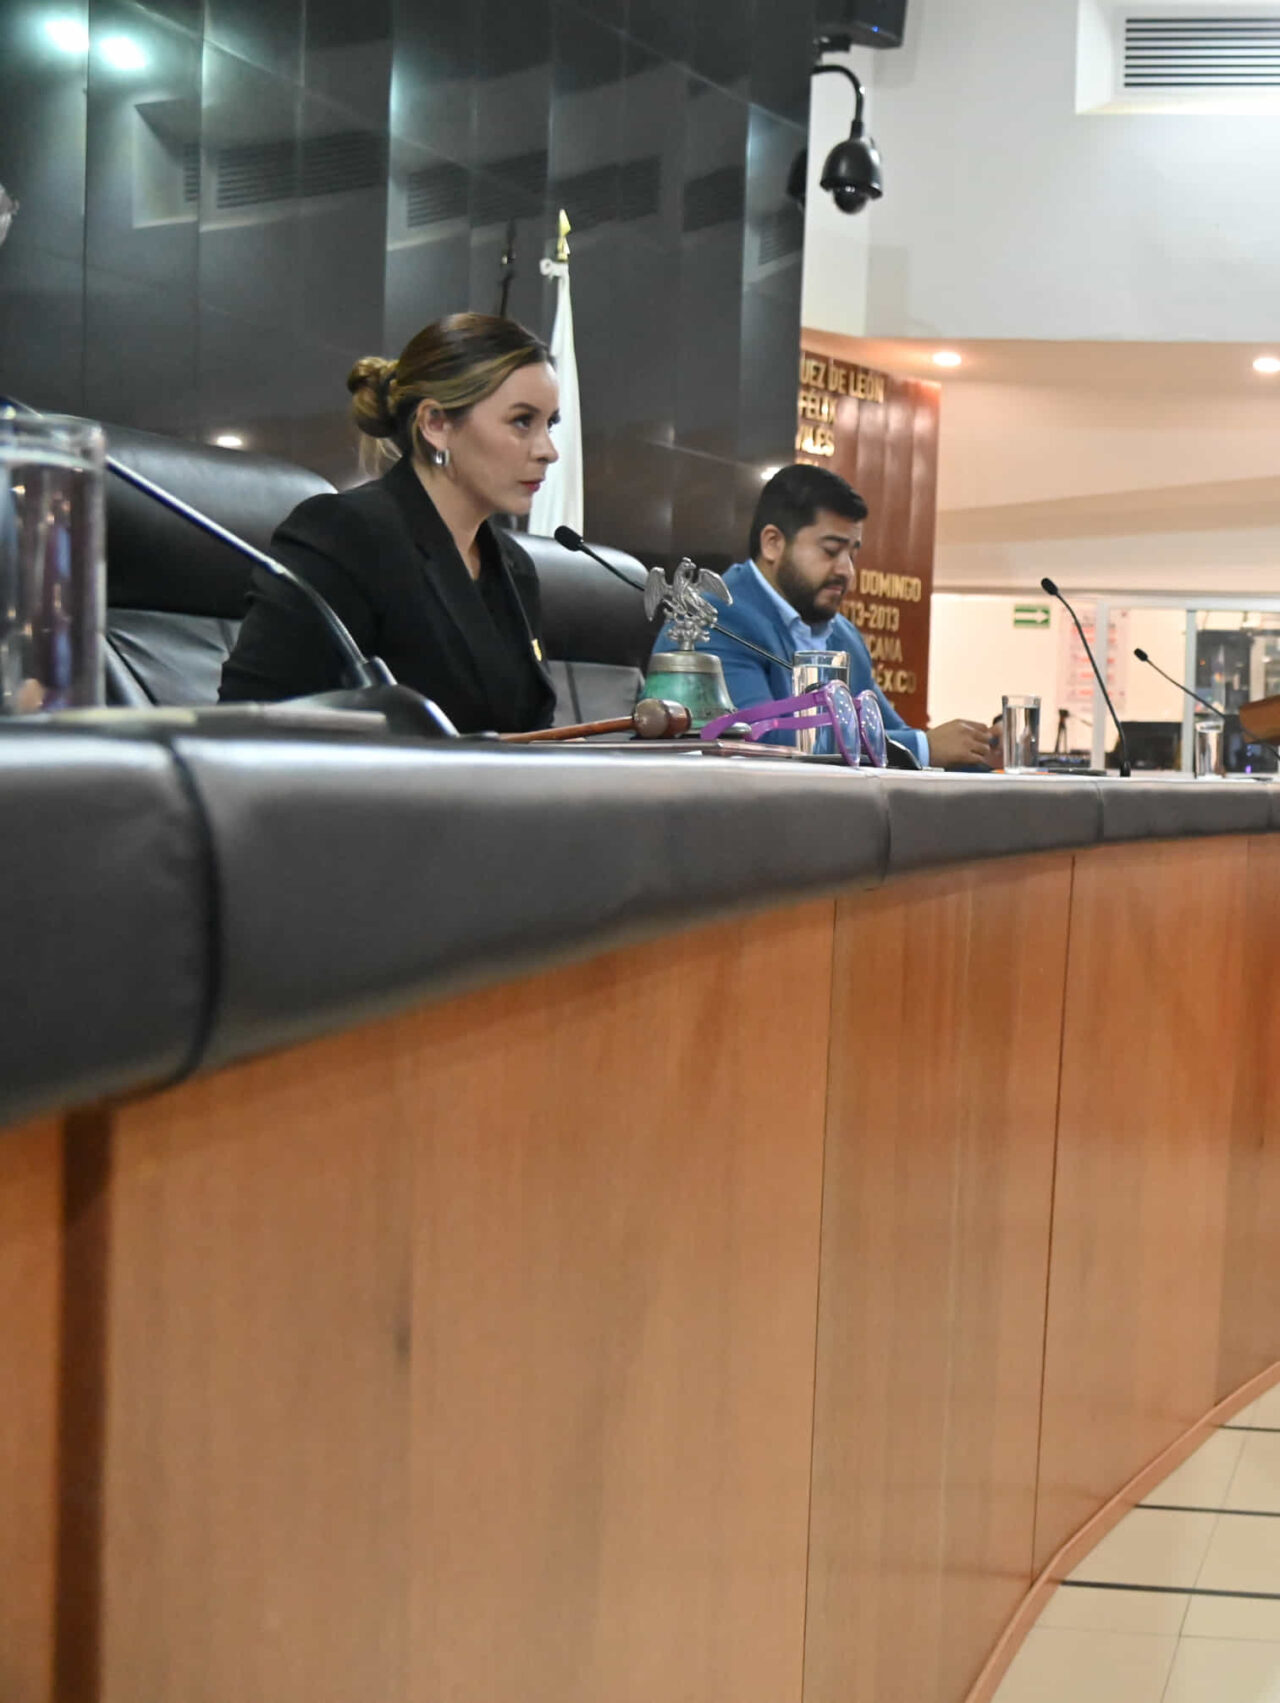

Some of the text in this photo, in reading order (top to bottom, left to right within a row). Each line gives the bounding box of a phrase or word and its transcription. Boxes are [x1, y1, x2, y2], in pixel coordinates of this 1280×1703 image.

[828, 365, 847, 393] DE
[860, 569, 922, 602] DOMINGO
[872, 663, 916, 693] ÉXICO
